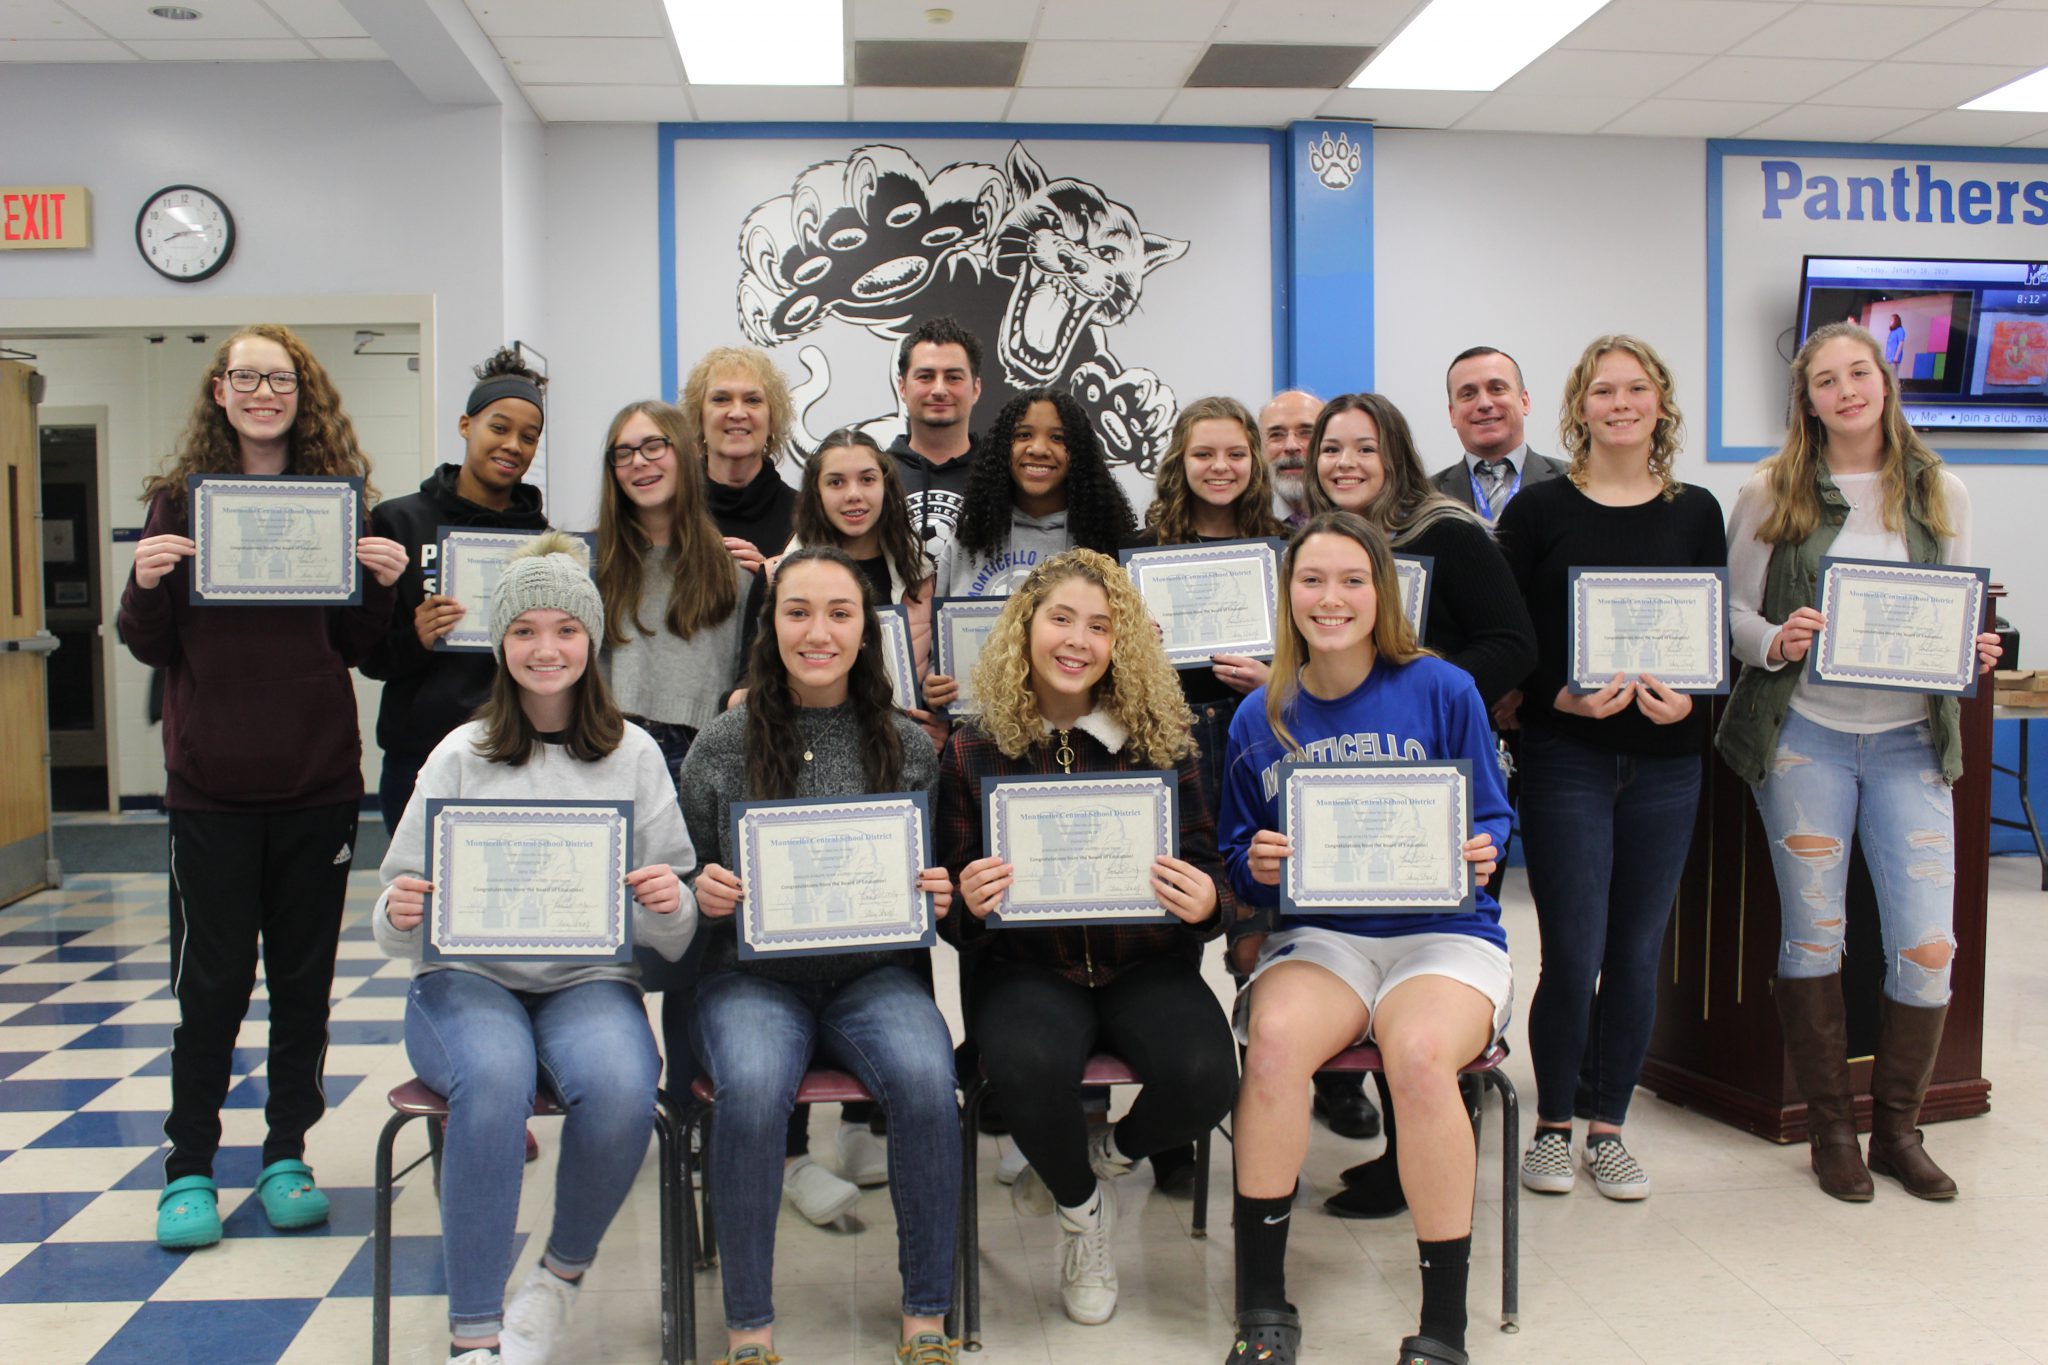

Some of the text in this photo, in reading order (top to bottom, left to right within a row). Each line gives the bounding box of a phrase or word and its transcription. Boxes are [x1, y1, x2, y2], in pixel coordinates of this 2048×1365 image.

[1761, 160, 2048, 226] Panthers
[4, 194, 65, 240] EXIT
[2017, 294, 2040, 304] 8:12
[1959, 412, 2048, 424] Join a club, mak
[1114, 809, 1141, 817] District
[865, 833, 892, 841] District
[565, 839, 593, 848] District
